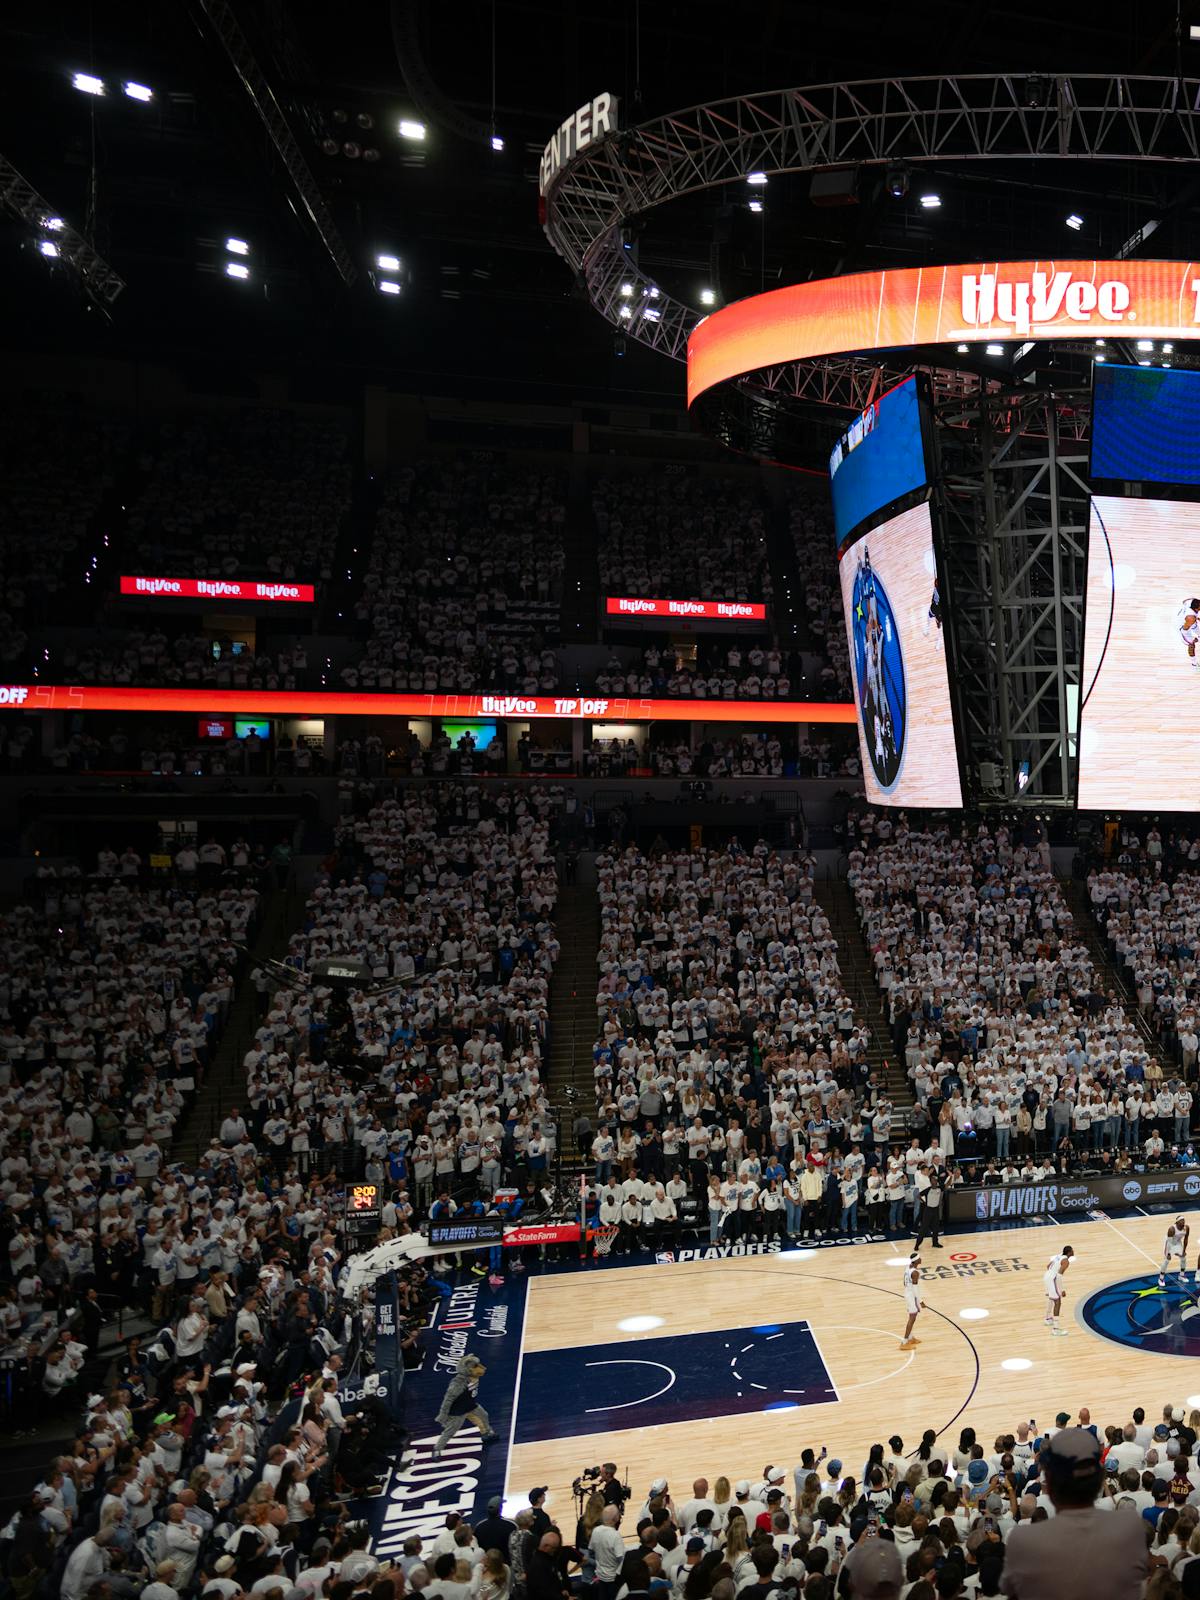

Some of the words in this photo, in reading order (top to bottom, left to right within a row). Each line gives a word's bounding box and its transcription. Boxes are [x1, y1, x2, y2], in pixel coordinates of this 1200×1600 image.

[961, 273, 1130, 334] HyVee
[137, 578, 180, 594] HyVee
[198, 581, 240, 596] HyVee
[257, 584, 299, 598] HyVee
[619, 600, 656, 614] HyVee
[670, 602, 705, 616] HyVee
[718, 603, 753, 617] HyVee
[0, 687, 28, 704] OFF
[482, 697, 537, 716] HyVee
[554, 699, 577, 714] TIP
[584, 701, 609, 715] OFF
[353, 1185, 376, 1196] 12:00
[1147, 1182, 1179, 1194] ESPN
[354, 1196, 371, 1208] 24
[990, 1186, 1058, 1216] PLAYOFFS
[1061, 1194, 1100, 1208] Google
[440, 1226, 477, 1241] PLAYOFFS
[796, 1233, 886, 1249] Google
[678, 1240, 782, 1263] PLAYOFFS
[920, 1263, 1030, 1281] CENTER
[921, 1257, 1022, 1274] TARGET
[380, 1304, 392, 1314] GET
[446, 1283, 480, 1322] ULTRA
[380, 1315, 392, 1323] THE
